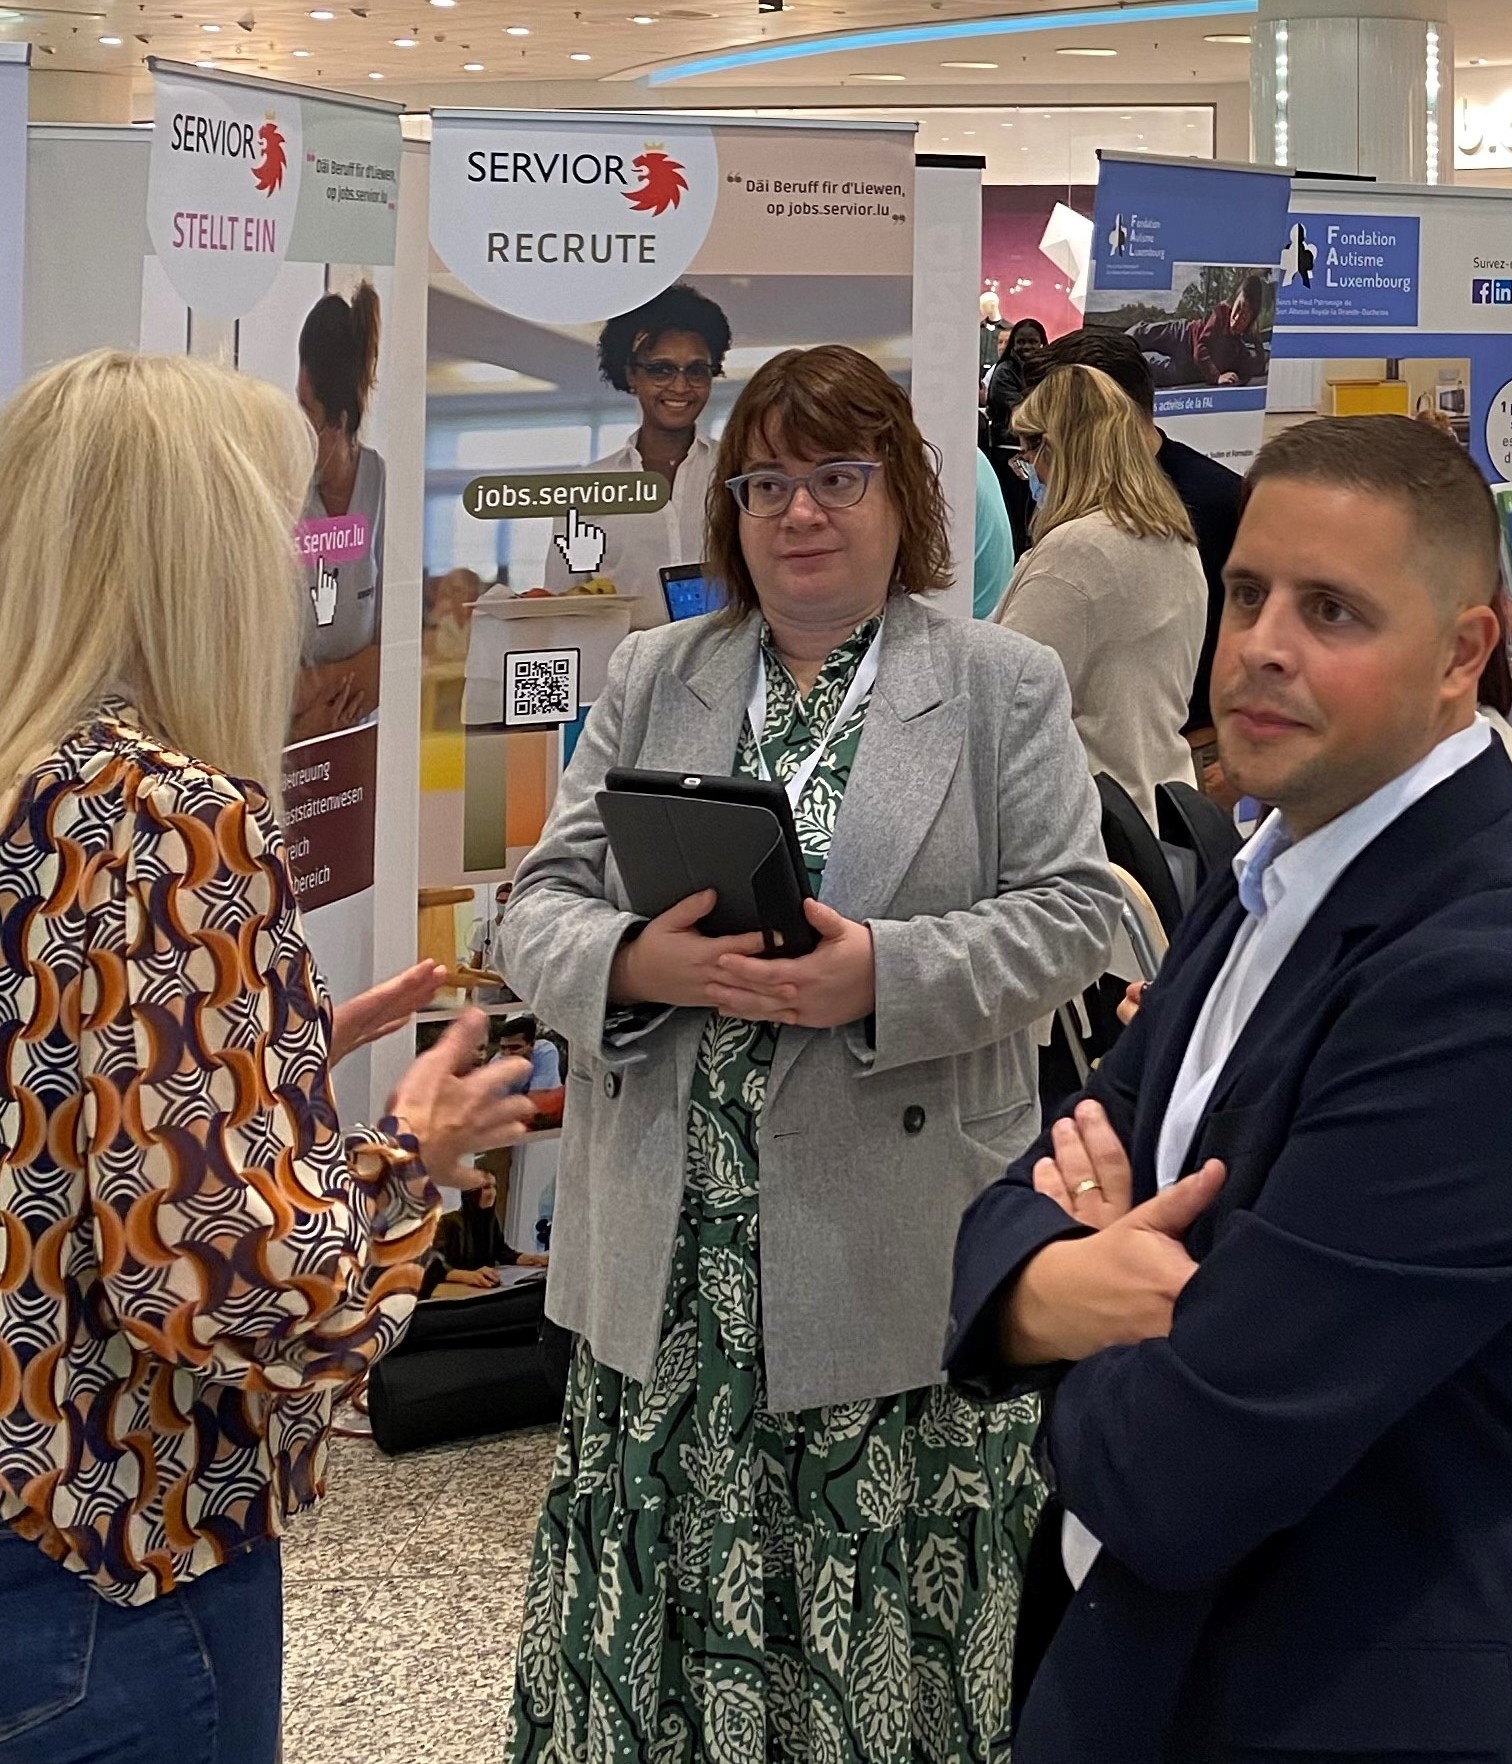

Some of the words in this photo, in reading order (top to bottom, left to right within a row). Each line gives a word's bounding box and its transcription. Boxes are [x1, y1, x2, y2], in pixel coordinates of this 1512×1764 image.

[171, 113, 256, 159] SERVIOR
[467, 151, 628, 185] SERVIOR
[746, 179, 769, 193] Däi
[774, 180, 820, 194] Beruff
[822, 181, 839, 194] fir
[841, 182, 906, 198] d'Liewen,
[766, 203, 785, 217] op
[788, 202, 889, 217] jobs.servior.lu
[172, 212, 239, 251] STELLT
[243, 217, 276, 253] EIN
[1327, 225, 1396, 246] Fondation
[487, 232, 656, 263] RECRUTE
[1326, 247, 1384, 267] Autisme
[1326, 268, 1411, 293] Luxembourg
[1501, 401, 1507, 413] 1
[473, 479, 658, 513] jobs.servior.lu
[284, 786, 363, 827] aststättenwesen
[286, 837, 310, 860] reich
